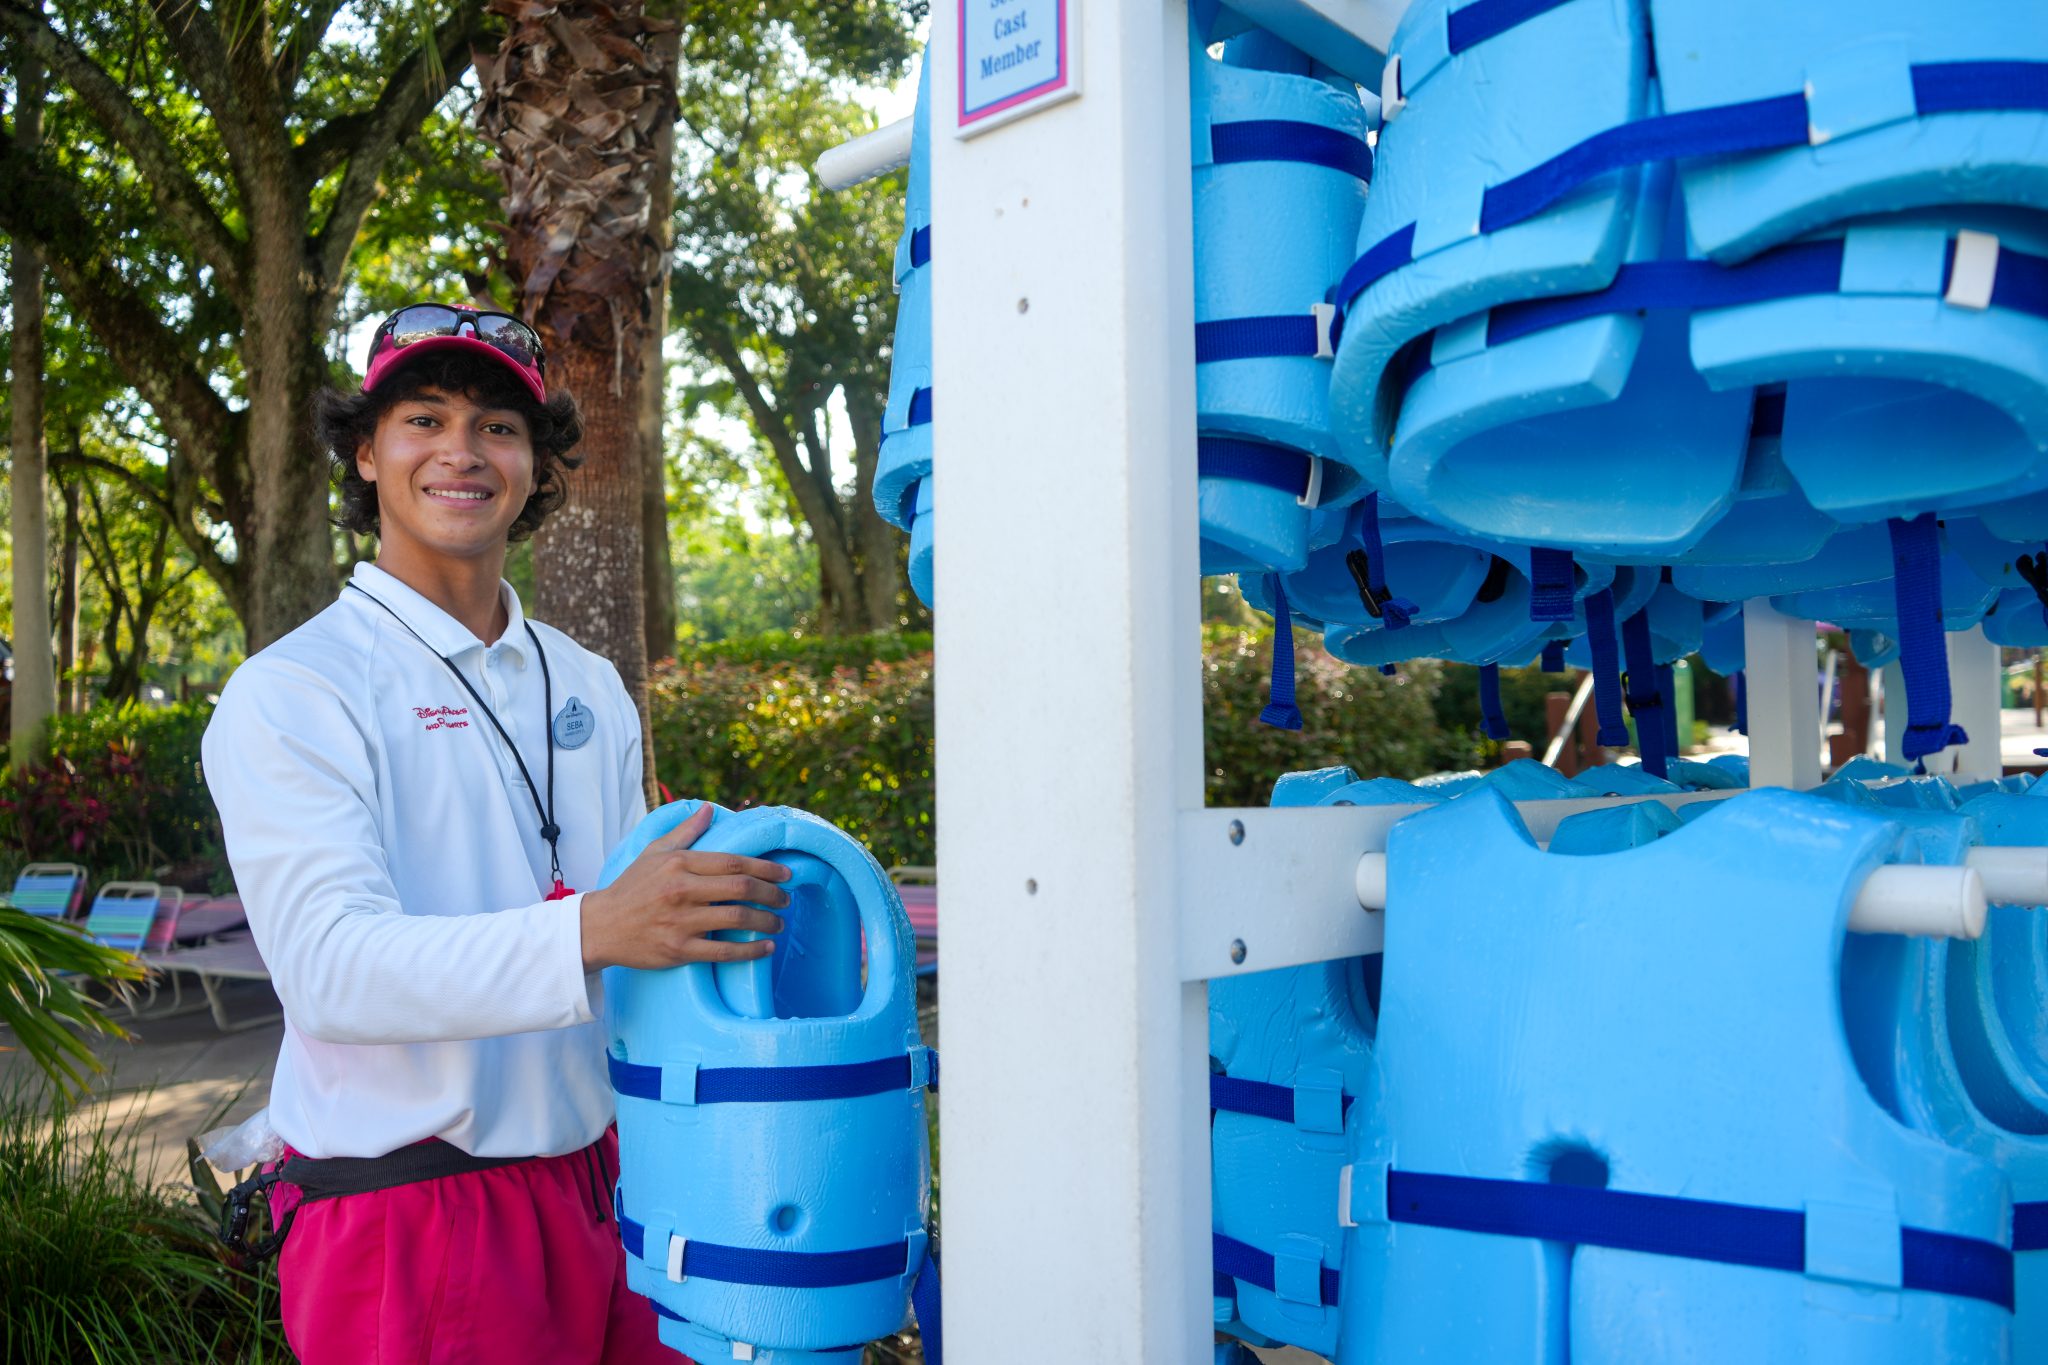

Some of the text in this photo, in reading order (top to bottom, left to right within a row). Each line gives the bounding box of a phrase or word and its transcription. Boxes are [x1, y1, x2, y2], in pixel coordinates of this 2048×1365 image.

[994, 10, 1027, 40] Cast
[980, 39, 1041, 79] Member
[566, 720, 584, 731] SEBA
